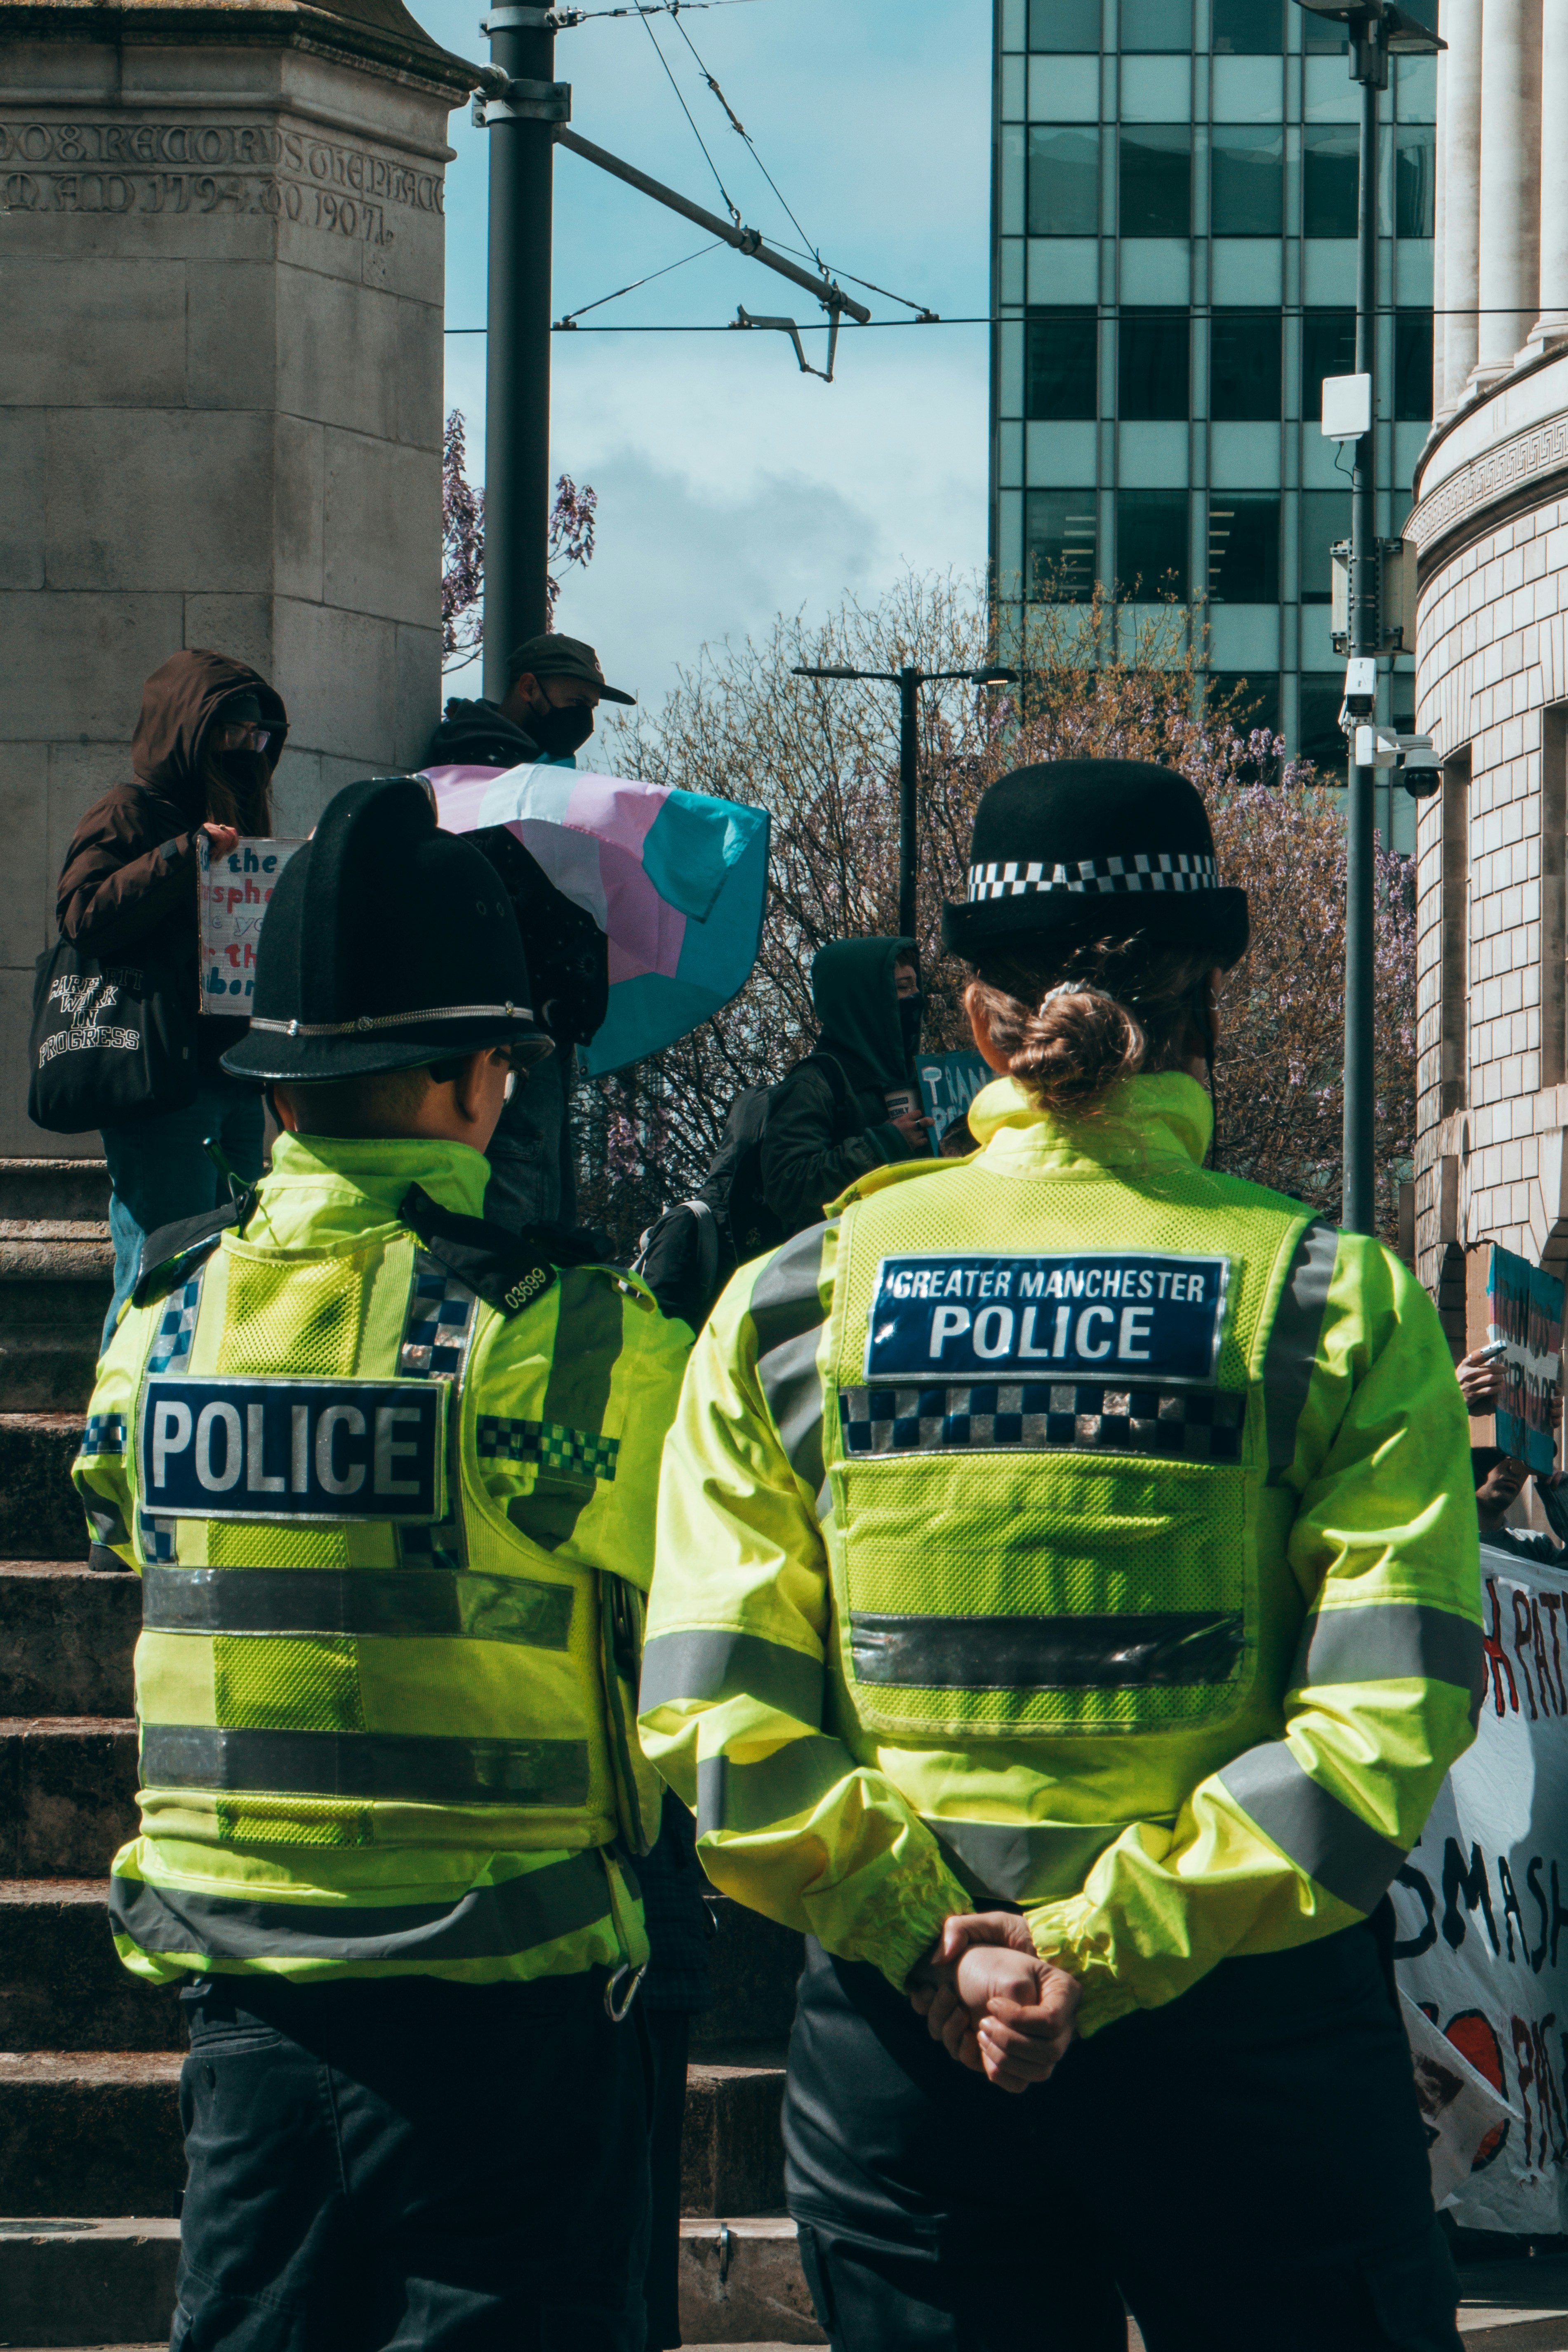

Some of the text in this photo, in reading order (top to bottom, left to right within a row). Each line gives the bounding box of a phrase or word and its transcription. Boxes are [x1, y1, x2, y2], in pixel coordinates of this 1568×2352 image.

[228, 848, 277, 873] the
[234, 917, 264, 937] yo
[225, 944, 257, 968] th
[61, 986, 118, 1013] WORK
[71, 1009, 99, 1029] IN
[39, 1026, 139, 1069] PROGRESS
[921, 1065, 987, 1109] TRAN
[504, 1267, 546, 1309] 03699
[893, 1269, 1205, 1302] GREATER MANCHESTER
[929, 1306, 1154, 1360] POLICE
[153, 1401, 421, 1495] POLICE
